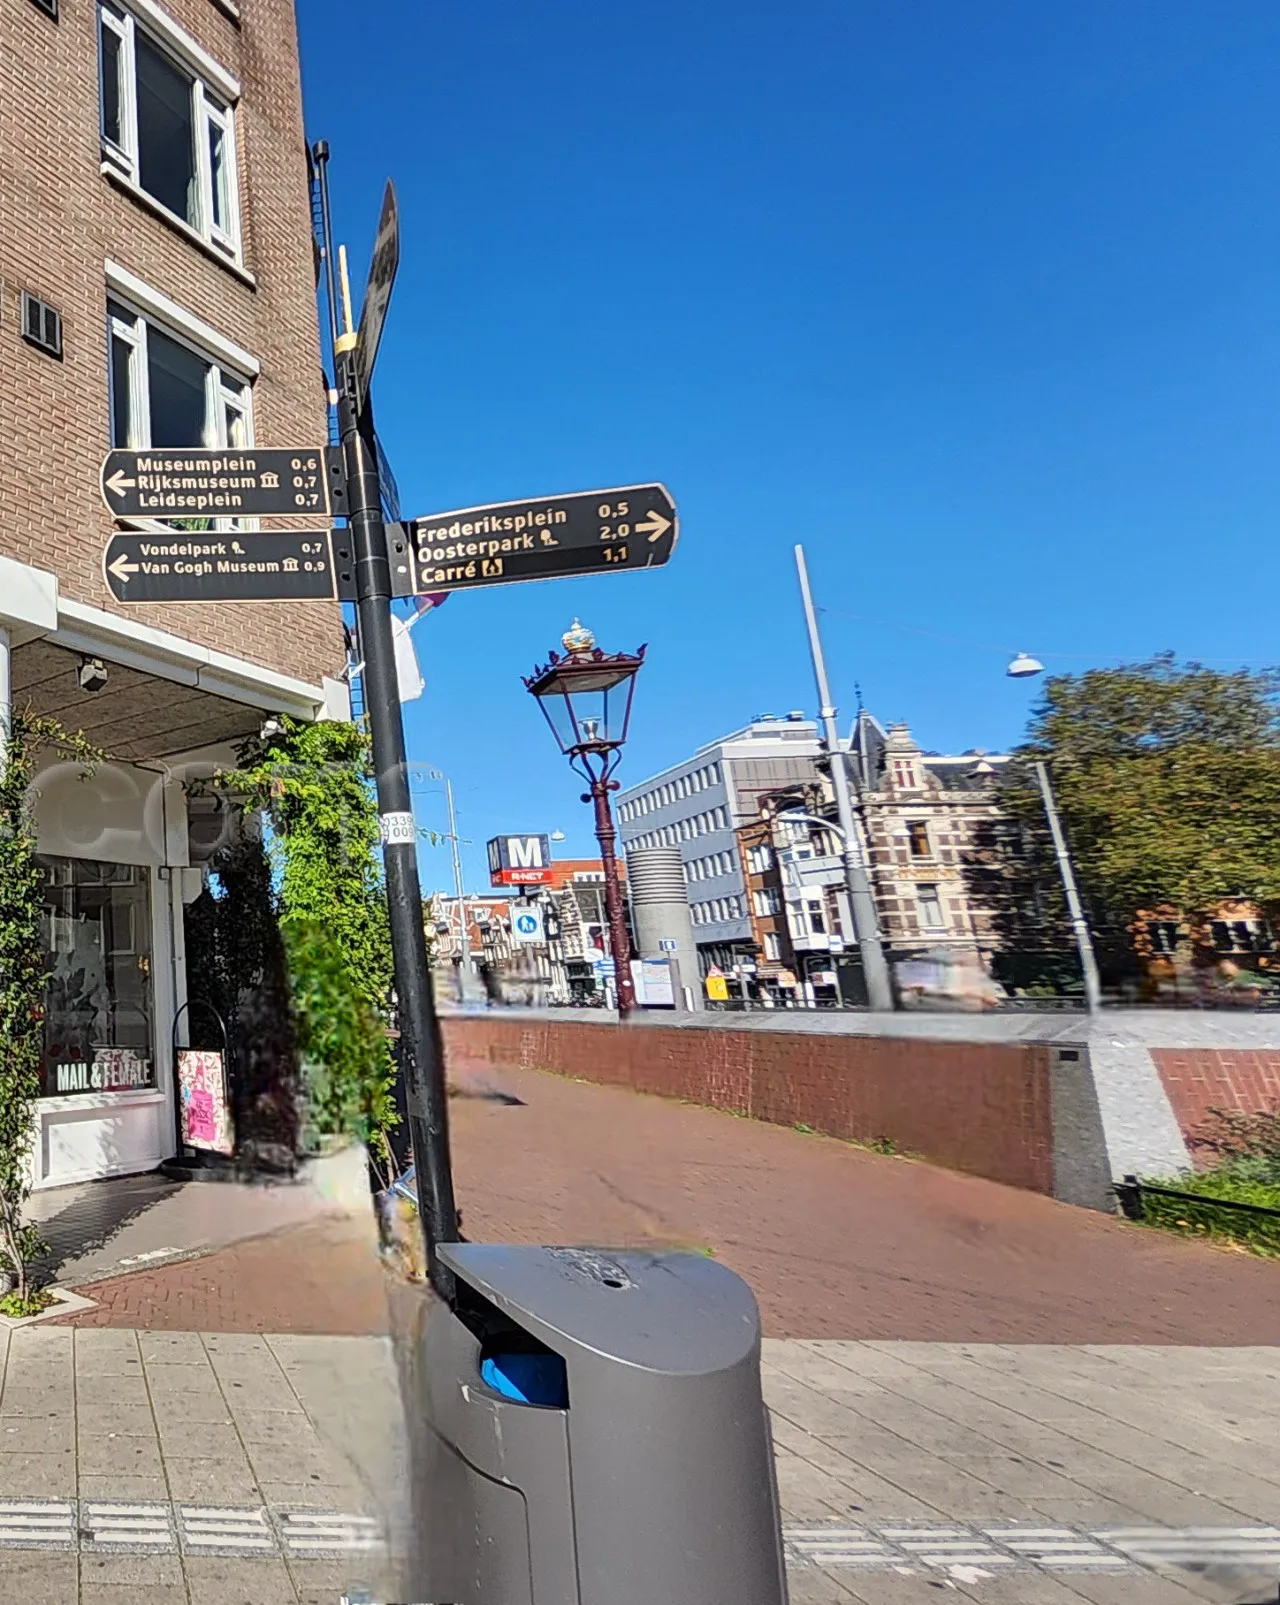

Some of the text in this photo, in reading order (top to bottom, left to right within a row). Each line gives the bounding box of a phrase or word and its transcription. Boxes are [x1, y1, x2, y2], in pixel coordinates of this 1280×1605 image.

[137, 457, 317, 474] Museumplein 0,6
[138, 475, 317, 493] Rijksmuseum 0,7
[139, 493, 319, 510] Leidseplein 0,7
[416, 502, 629, 544] Frederiksplein 0,5
[140, 542, 322, 558] Vondelpark 0,7
[418, 523, 630, 563] Oosterpark 2,0
[141, 560, 325, 576] Van Gogh Museum 0,9
[421, 546, 628, 584] Carré 1,1
[508, 838, 542, 867] M
[57, 1058, 151, 1091] MAIL & FEMALE
